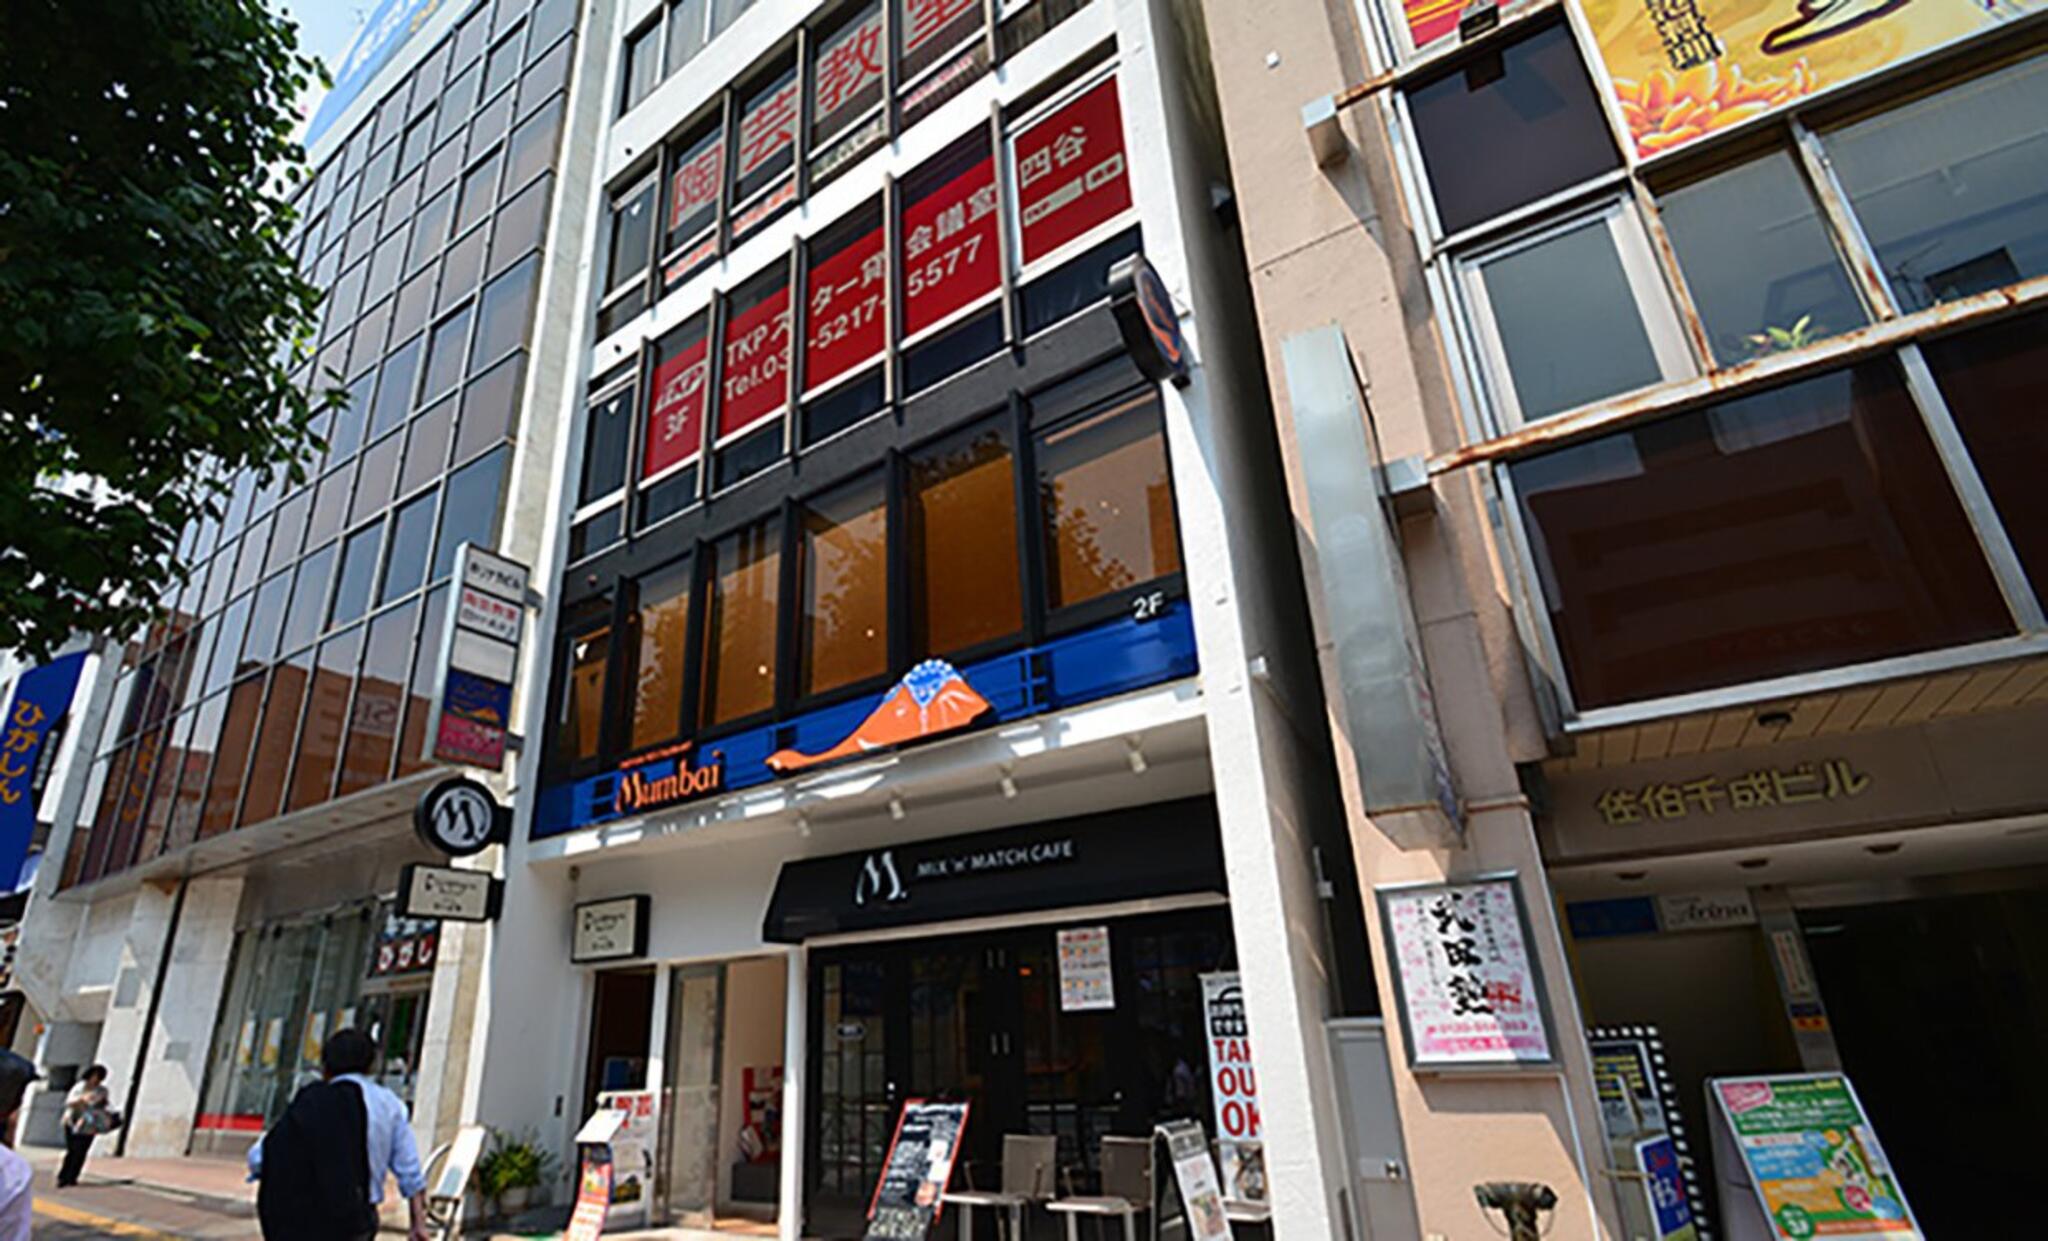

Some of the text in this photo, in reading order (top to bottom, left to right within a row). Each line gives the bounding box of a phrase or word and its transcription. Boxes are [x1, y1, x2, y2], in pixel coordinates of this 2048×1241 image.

[664, 405, 690, 442] 3F
[1133, 591, 1163, 619] 2F
[0, 699, 46, 804] ひがしん
[614, 750, 720, 812] Mumbai
[917, 861, 948, 876] MIX
[971, 849, 1027, 869] MATCH
[1031, 839, 1073, 862] CAFE
